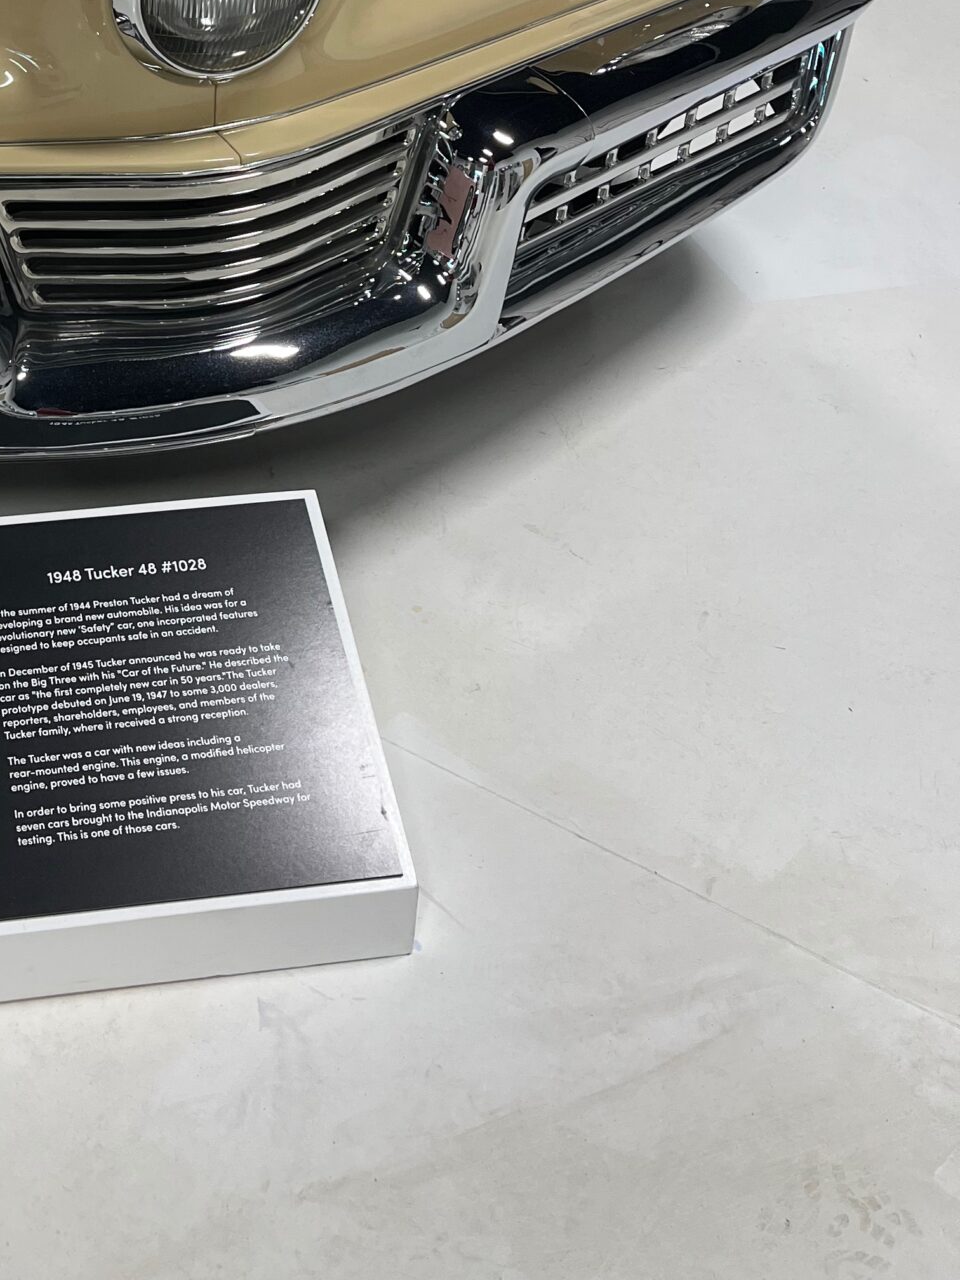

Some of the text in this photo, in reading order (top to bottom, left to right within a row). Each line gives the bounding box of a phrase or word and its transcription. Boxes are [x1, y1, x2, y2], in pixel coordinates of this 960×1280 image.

[46, 558, 206, 583] 1948 Tucker 48 #1028
[17, 590, 222, 615] summer 1944 Preston Tucker had dream
[53, 612, 83, 624] brand
[106, 606, 162, 619] automobile.
[164, 604, 179, 613] His
[180, 603, 202, 611] idea
[156, 612, 217, 625] incorporated
[218, 610, 257, 620] features
[51, 639, 74, 648] keep
[76, 633, 126, 645] occupants
[127, 630, 148, 640] safe
[175, 624, 218, 636] accident.
[7, 642, 280, 676] December 1945 Tucker announced ready take
[30, 677, 47, 688] Big
[48, 675, 76, 685] Three
[78, 671, 99, 681] with
[100, 671, 115, 679] his
[224, 654, 271, 667] described
[0, 694, 15, 702] car
[53, 687, 72, 696] first
[74, 681, 127, 695] completely
[129, 681, 149, 689] new
[151, 679, 167, 687] car
[180, 675, 193, 684] 50
[245, 667, 275, 677] Tucker
[0, 680, 277, 717] prototype debuted June 19, 1947 some 3,000 dealers,
[2, 696, 245, 728] reporters, shareholders, employees, and members
[3, 709, 248, 739] Tucker family, where received strong reception.
[7, 735, 231, 765] The Tucker car with new ideas including
[9, 743, 283, 778] rear-mounted engine. This engine, modified helicopter
[10, 767, 189, 793] engine, proved have few issues.
[15, 795, 294, 832] seven cars brought Indianapolis Motor Speedway
[26, 780, 300, 817] order bring some positive press his car, Tucker had
[17, 822, 179, 845] testing. This one those cars.
